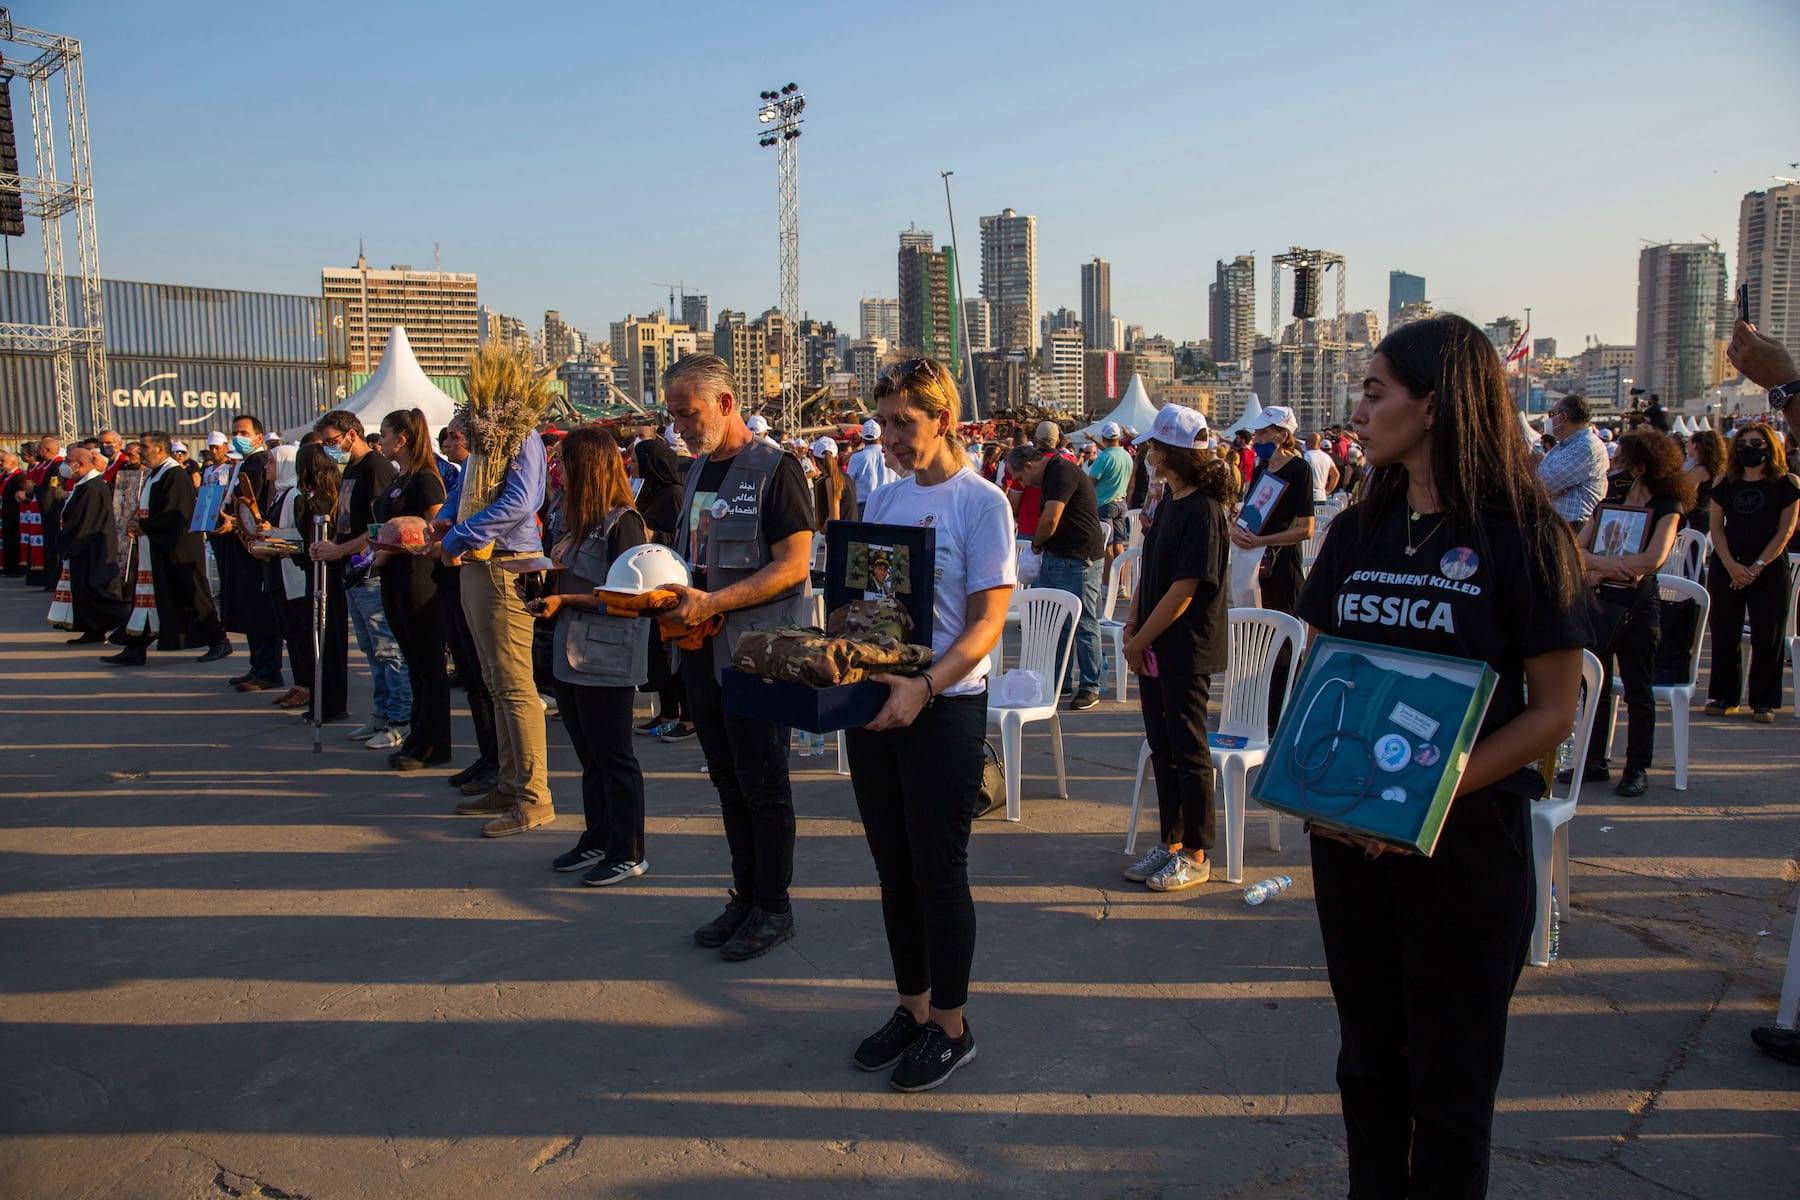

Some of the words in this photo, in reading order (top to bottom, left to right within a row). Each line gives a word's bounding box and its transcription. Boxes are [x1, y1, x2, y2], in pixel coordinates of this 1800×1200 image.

[333, 315, 344, 328] 45
[112, 388, 177, 408] CMA
[182, 390, 241, 409] CGM
[336, 385, 346, 399] 45
[739, 481, 755, 491] لجنة
[1352, 570, 1429, 586] GOVERMENT
[1429, 575, 1482, 596] KILLED
